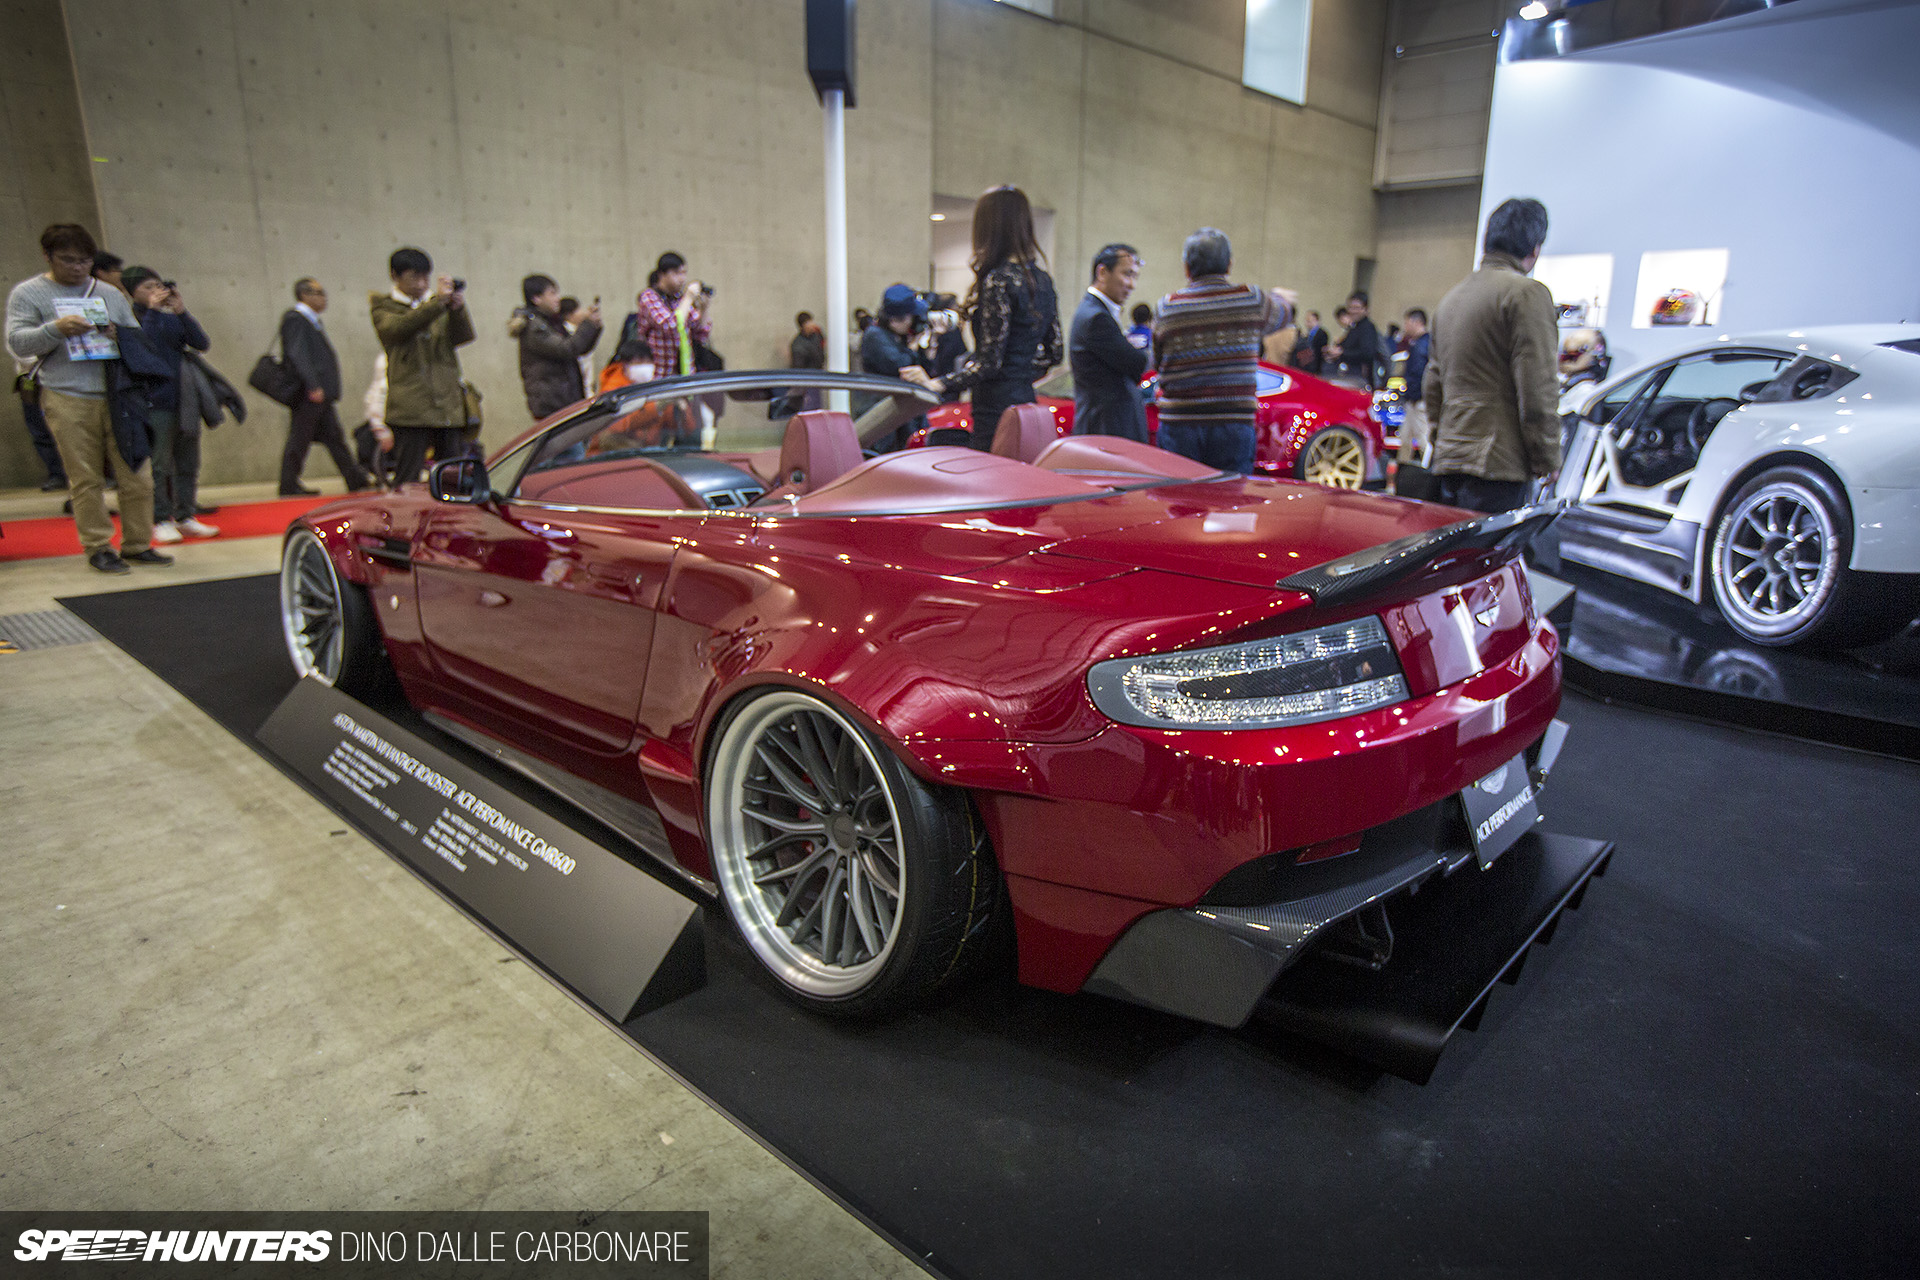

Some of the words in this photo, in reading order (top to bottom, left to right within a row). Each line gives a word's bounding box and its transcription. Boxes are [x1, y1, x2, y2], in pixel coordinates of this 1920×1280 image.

[414, 763, 458, 799] ROADSTER
[453, 789, 477, 812] ACR
[529, 837, 577, 875] GMR600
